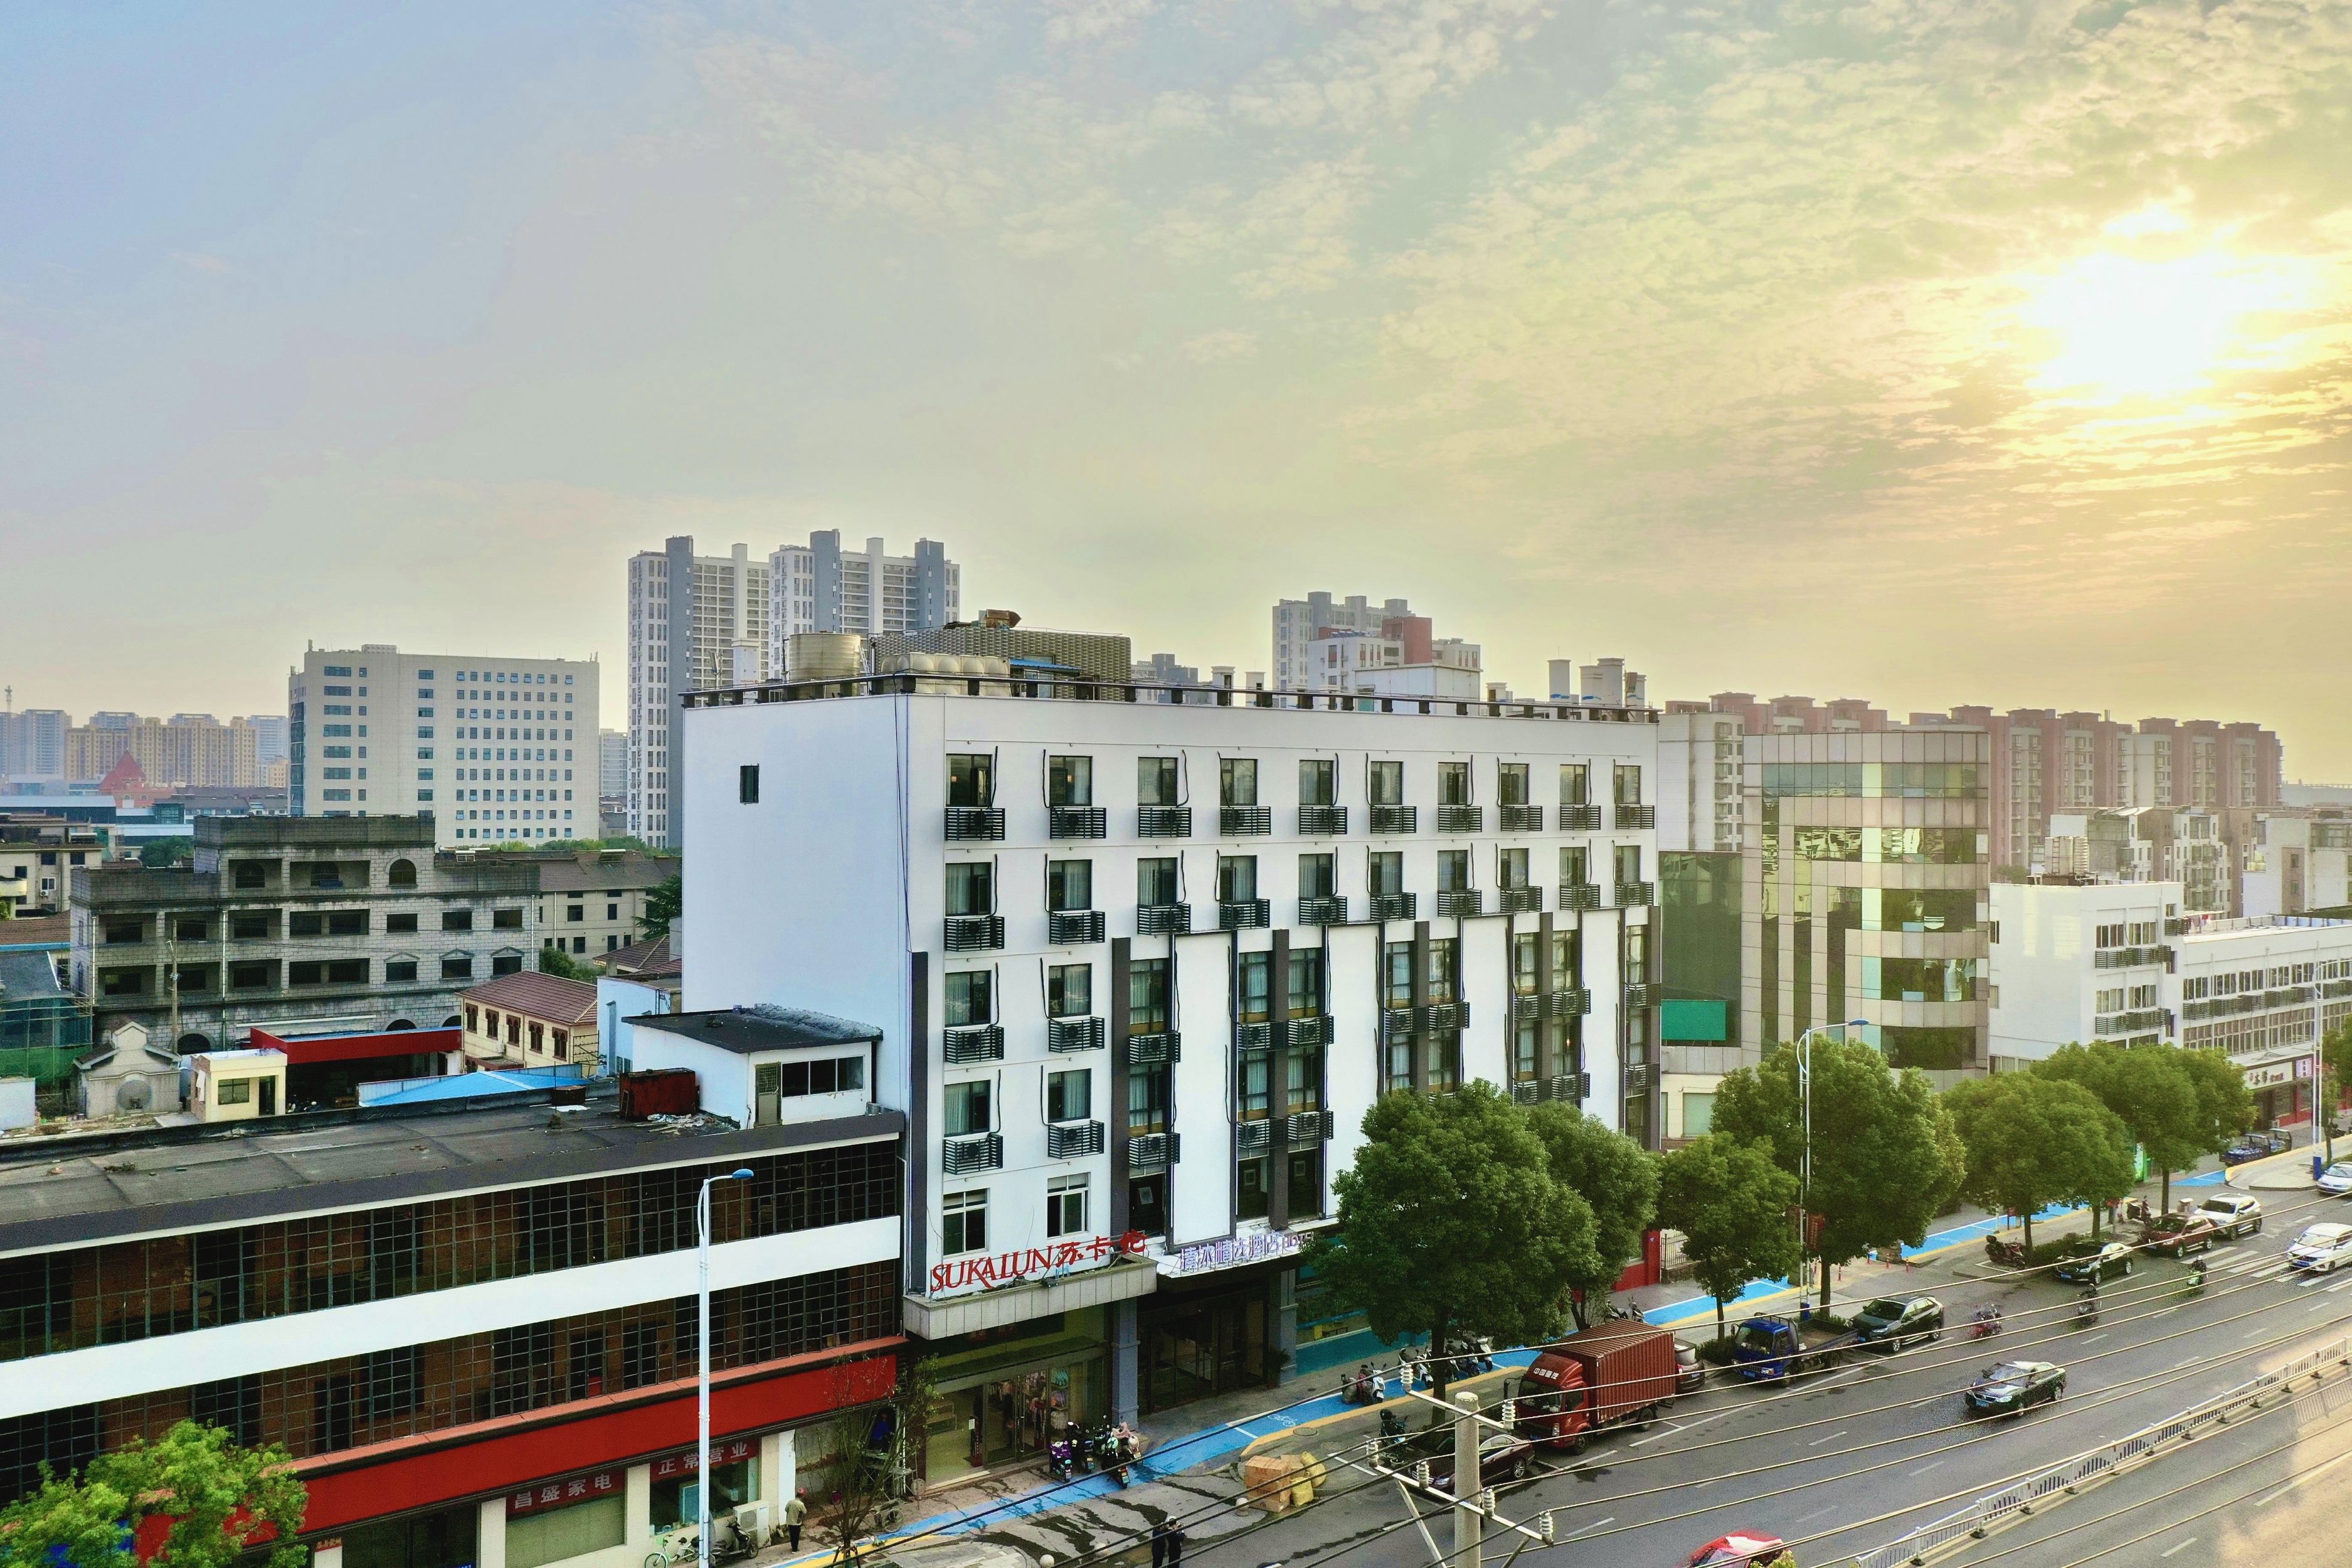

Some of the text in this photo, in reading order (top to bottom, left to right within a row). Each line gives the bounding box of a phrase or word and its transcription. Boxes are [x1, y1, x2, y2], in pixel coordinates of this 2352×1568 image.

[931, 1229, 1148, 1292] SUKALUN 苏卡伦
[659, 1441, 748, 1475] 正常营业
[514, 1473, 612, 1509] 昌盛家电
